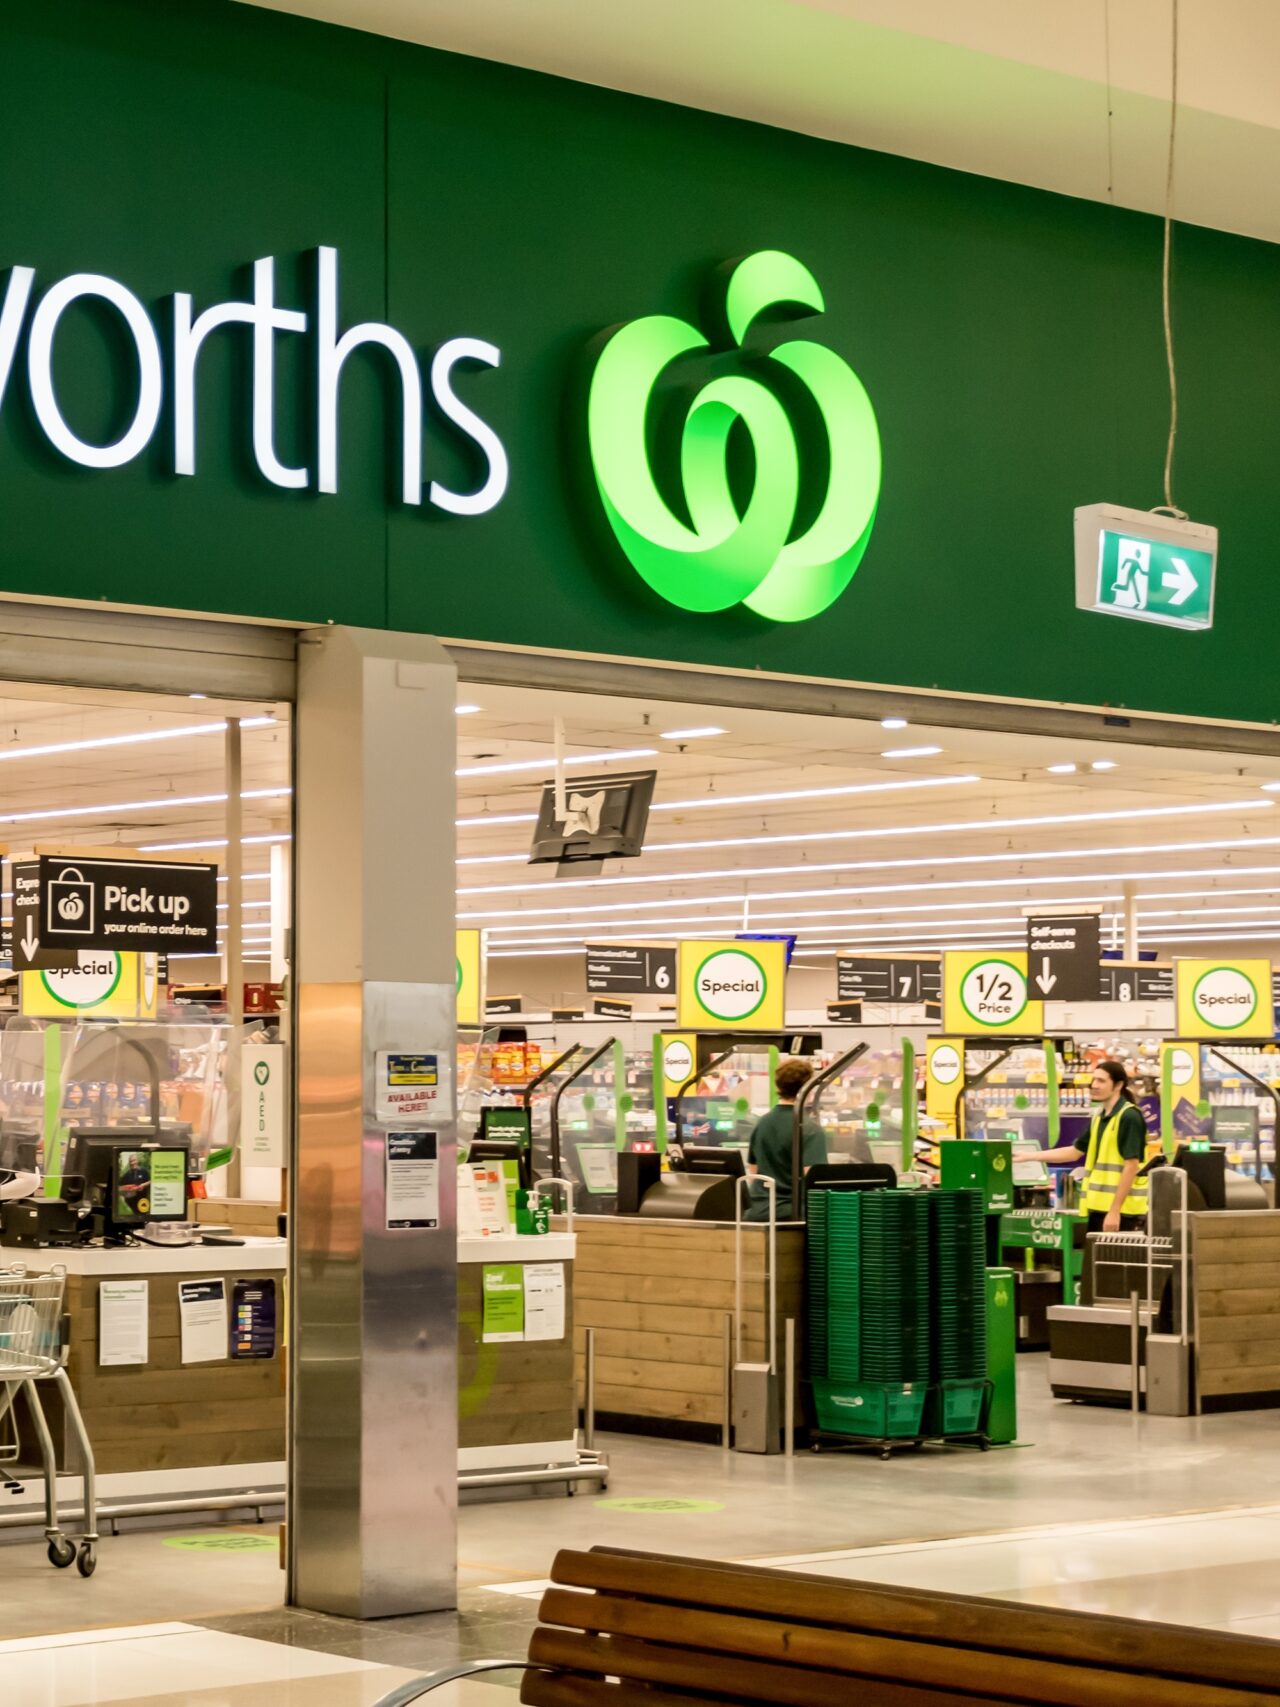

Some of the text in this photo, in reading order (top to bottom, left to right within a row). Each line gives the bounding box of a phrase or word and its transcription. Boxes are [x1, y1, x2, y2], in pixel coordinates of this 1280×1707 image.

[16, 878, 40, 891] Expre
[16, 895, 40, 906] check
[104, 886, 190, 921] Pick up
[104, 922, 207, 936] your online order here
[655, 966, 670, 989] 6
[701, 979, 760, 995] Special
[899, 976, 912, 997] 7
[976, 974, 1013, 1001] 1/2
[1119, 983, 1131, 1002] 8
[1199, 993, 1251, 1007] Special
[979, 1003, 1011, 1014] Price
[388, 1090, 437, 1103] AVAILABLE
